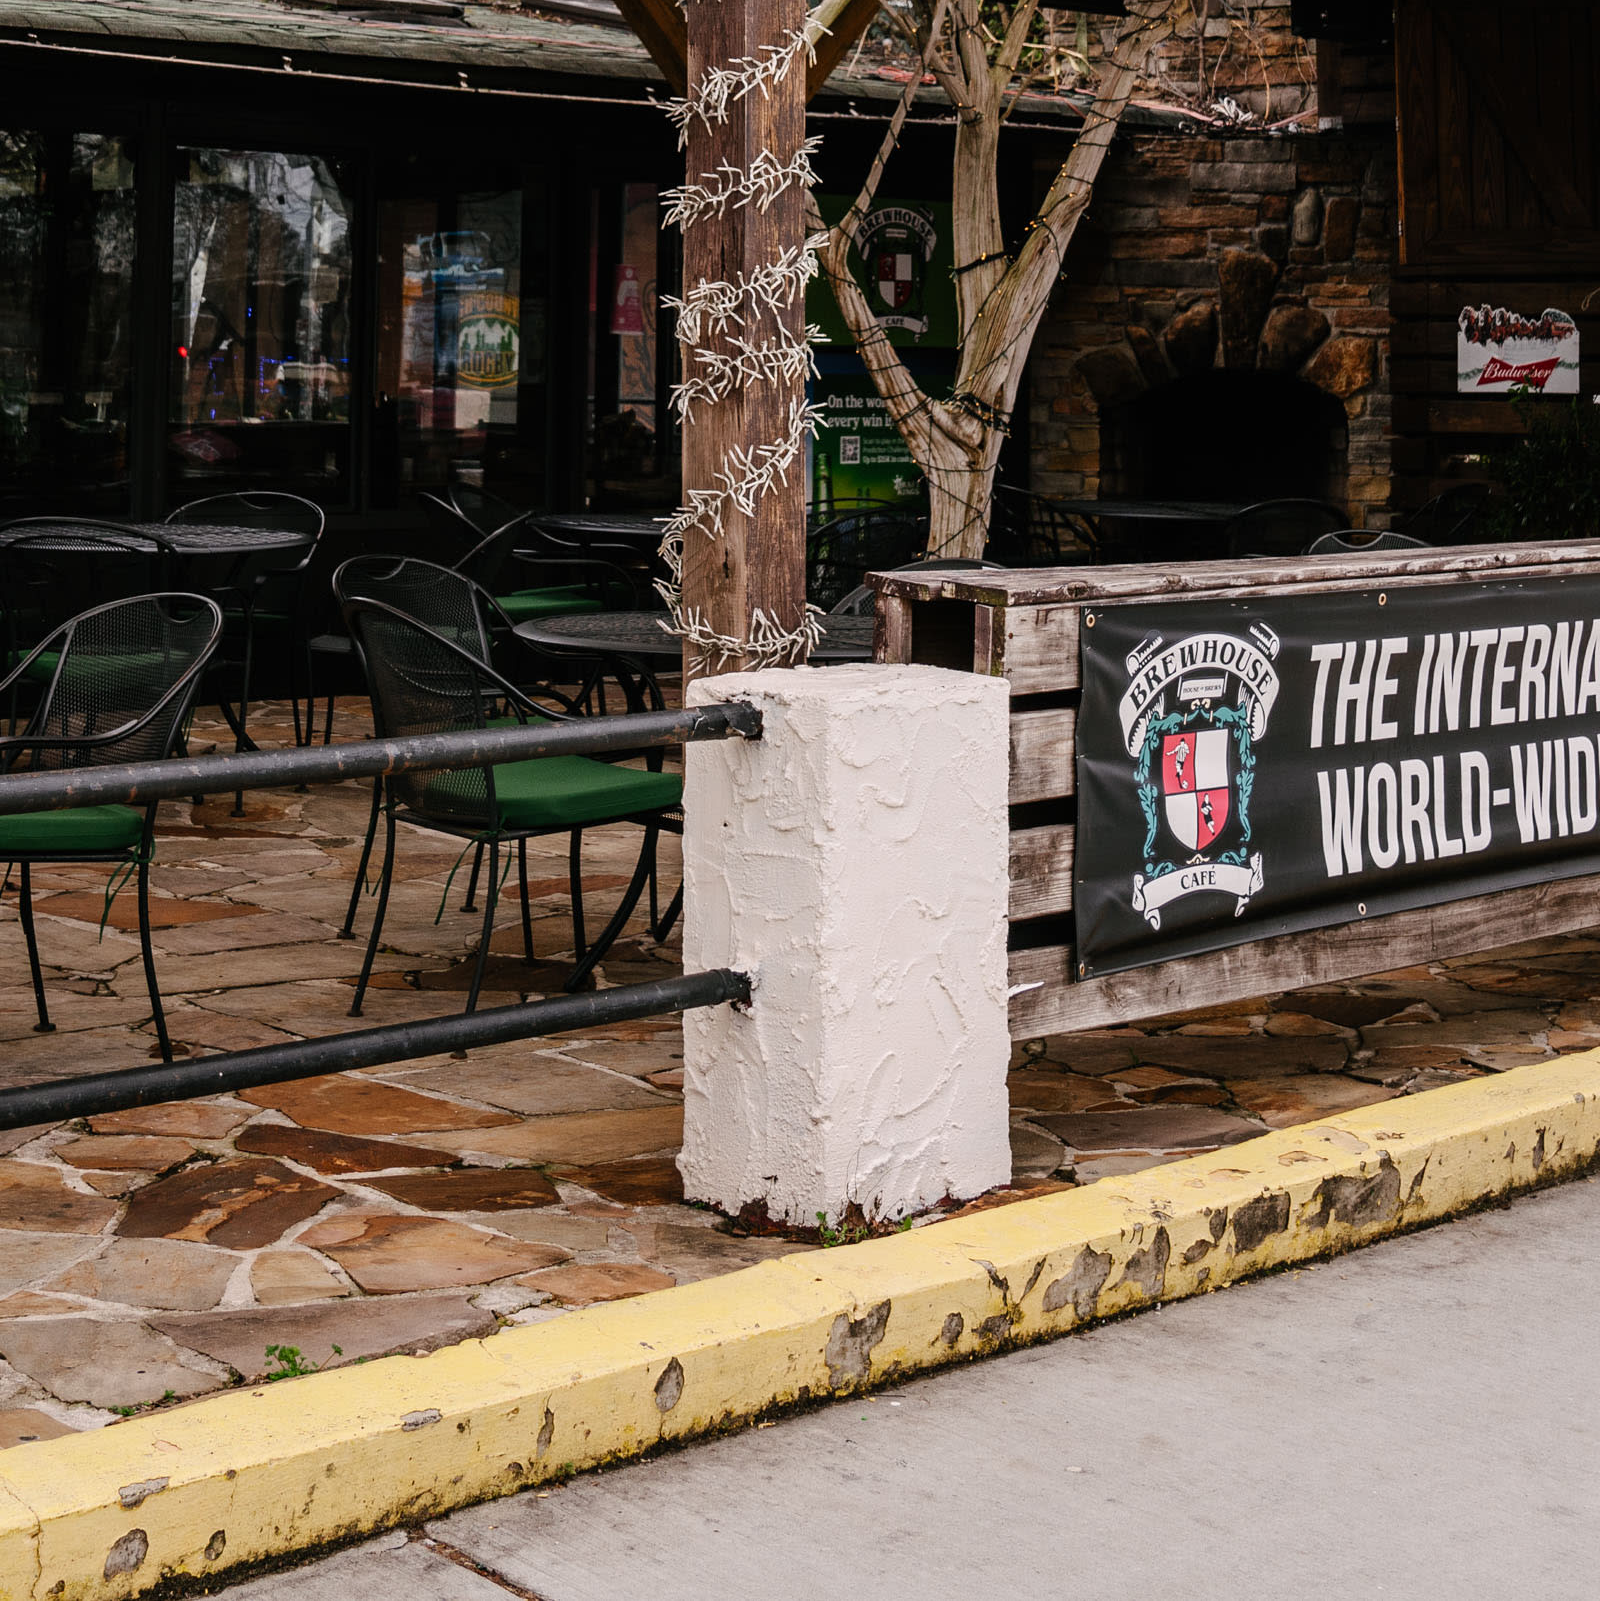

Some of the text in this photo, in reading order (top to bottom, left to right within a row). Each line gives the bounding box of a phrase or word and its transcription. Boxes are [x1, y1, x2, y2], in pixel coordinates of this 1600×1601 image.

[827, 393, 843, 409] On
[845, 394, 864, 409] the
[826, 416, 860, 431] every
[861, 413, 883, 428] win
[1129, 639, 1276, 713] BREWHOUSE
[1309, 636, 1409, 749] THE
[1180, 864, 1217, 890] CAFÉ
